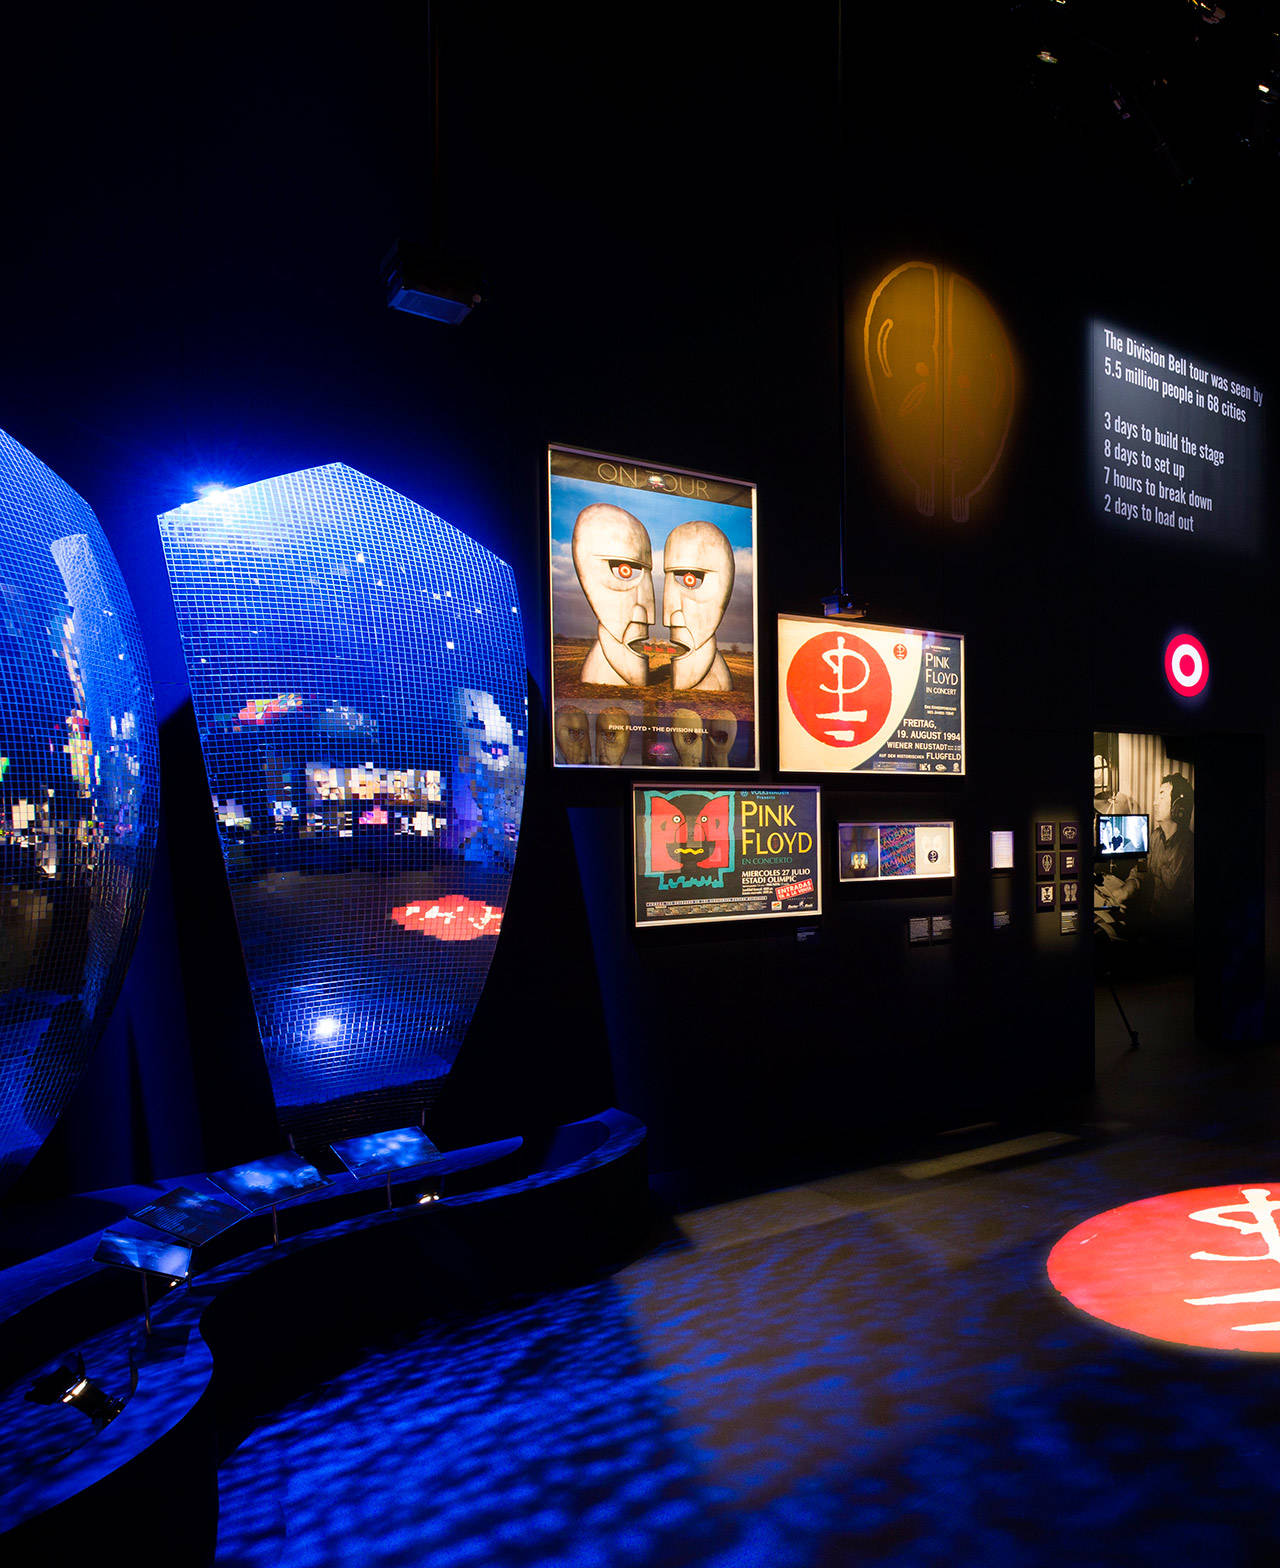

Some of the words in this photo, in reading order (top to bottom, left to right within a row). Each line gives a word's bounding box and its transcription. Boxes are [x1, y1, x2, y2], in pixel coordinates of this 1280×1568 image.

[1104, 328, 1123, 352] The
[1127, 338, 1165, 368] Division
[1169, 354, 1186, 377] Bell
[1189, 363, 1208, 384] tour
[1211, 374, 1228, 391] was
[1231, 381, 1250, 400] seen
[1254, 386, 1263, 407] by
[1105, 357, 1122, 379] 5.5
[1125, 367, 1159, 392] million
[1162, 381, 1193, 404] people
[1196, 390, 1204, 408] in
[1208, 394, 1219, 413] 68
[1222, 401, 1246, 423] cities
[1105, 412, 1111, 430] 3
[1115, 416, 1138, 440] days
[1141, 424, 1151, 442] to
[1155, 428, 1178, 451] build
[1181, 436, 1196, 456] the
[1200, 442, 1224, 467] stage
[1104, 439, 1111, 457] 8
[1115, 443, 1138, 467] days
[1141, 451, 1151, 470] to
[1155, 457, 1170, 475] set
[1174, 463, 1185, 481] up
[598, 463, 637, 487] ON
[1104, 467, 1110, 484] 7
[1114, 469, 1142, 494] hours
[1146, 479, 1155, 496] to
[1159, 481, 1186, 505] break
[1189, 490, 1212, 511] down
[1104, 494, 1111, 512] 2
[1115, 497, 1138, 520] days
[1141, 504, 1151, 522] to
[1155, 506, 1175, 528] load
[1178, 515, 1194, 533] out
[925, 653, 950, 669] PINK
[925, 669, 958, 685] FLOYD
[933, 687, 956, 695] CONCERT
[903, 719, 937, 729] FREITAG,
[897, 730, 908, 738] 19.
[911, 731, 941, 740] AUGUST
[943, 732, 960, 741] 1994
[887, 741, 912, 749] WIENER
[915, 742, 947, 750] NEUSTADT
[926, 752, 961, 760] FLUGFELD
[741, 800, 797, 827] PINK
[742, 829, 812, 855] FLOYD
[753, 857, 792, 865] CONCIERTO
[742, 869, 780, 878] MIERCOLES
[791, 868, 810, 876] JULIO
[777, 881, 811, 894] ENTRADAS
